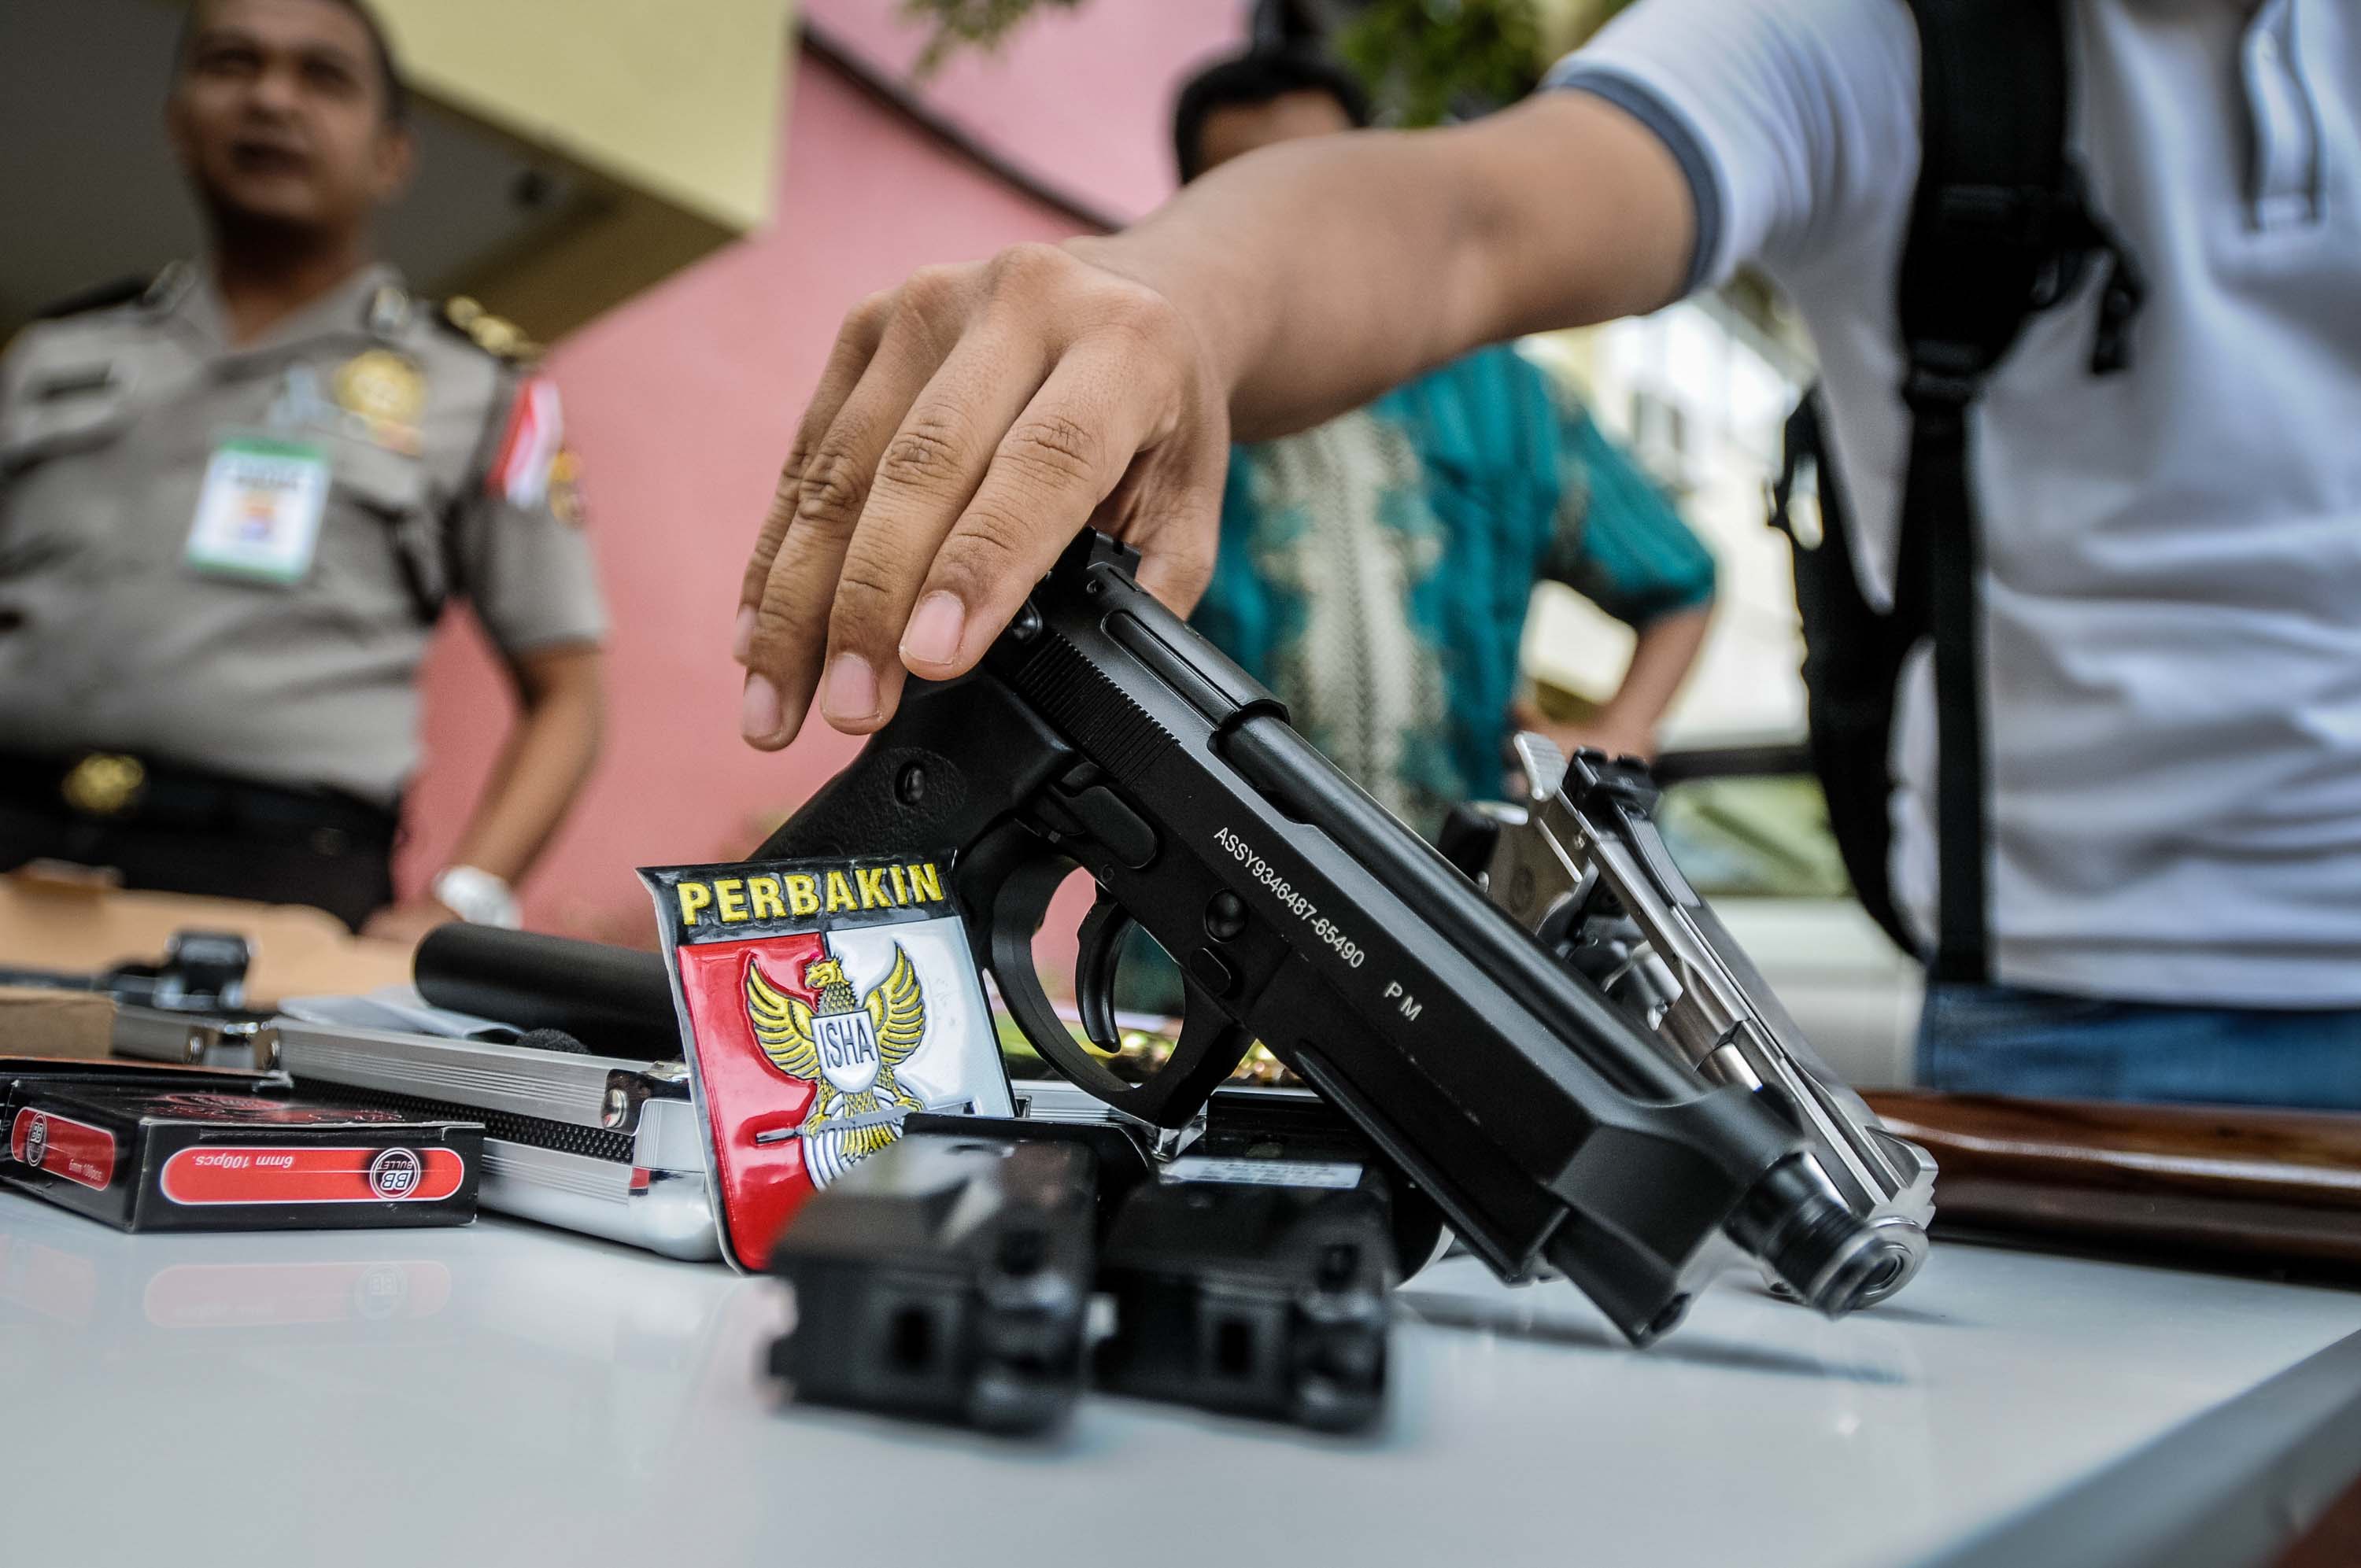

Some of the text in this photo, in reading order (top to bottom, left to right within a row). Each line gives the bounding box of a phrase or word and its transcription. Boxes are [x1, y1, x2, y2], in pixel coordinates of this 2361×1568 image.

[677, 863, 944, 925] PERBAKIN
[1213, 826, 1365, 968] ASSY9346487-65490
[818, 1018, 876, 1069] ISHA
[192, 1152, 294, 1169] 6mm 100pcs.
[376, 1160, 415, 1170] BULLET
[380, 1170, 413, 1191] BB
